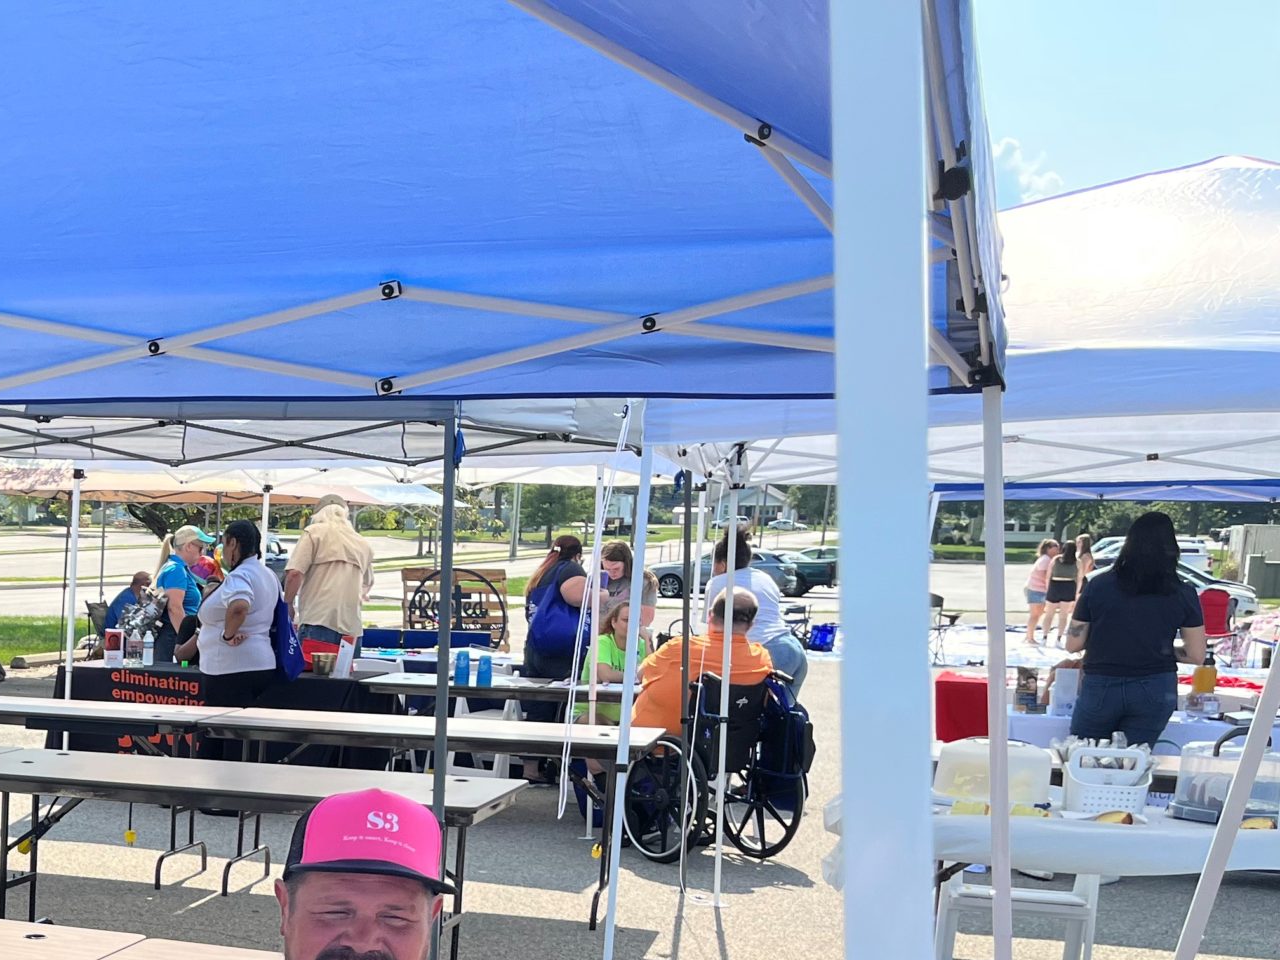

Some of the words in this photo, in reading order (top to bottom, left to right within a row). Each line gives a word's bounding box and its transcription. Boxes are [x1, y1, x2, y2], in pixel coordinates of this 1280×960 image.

[410, 585, 488, 626] Roted
[111, 669, 199, 695] eliminating
[366, 810, 400, 833] S3
